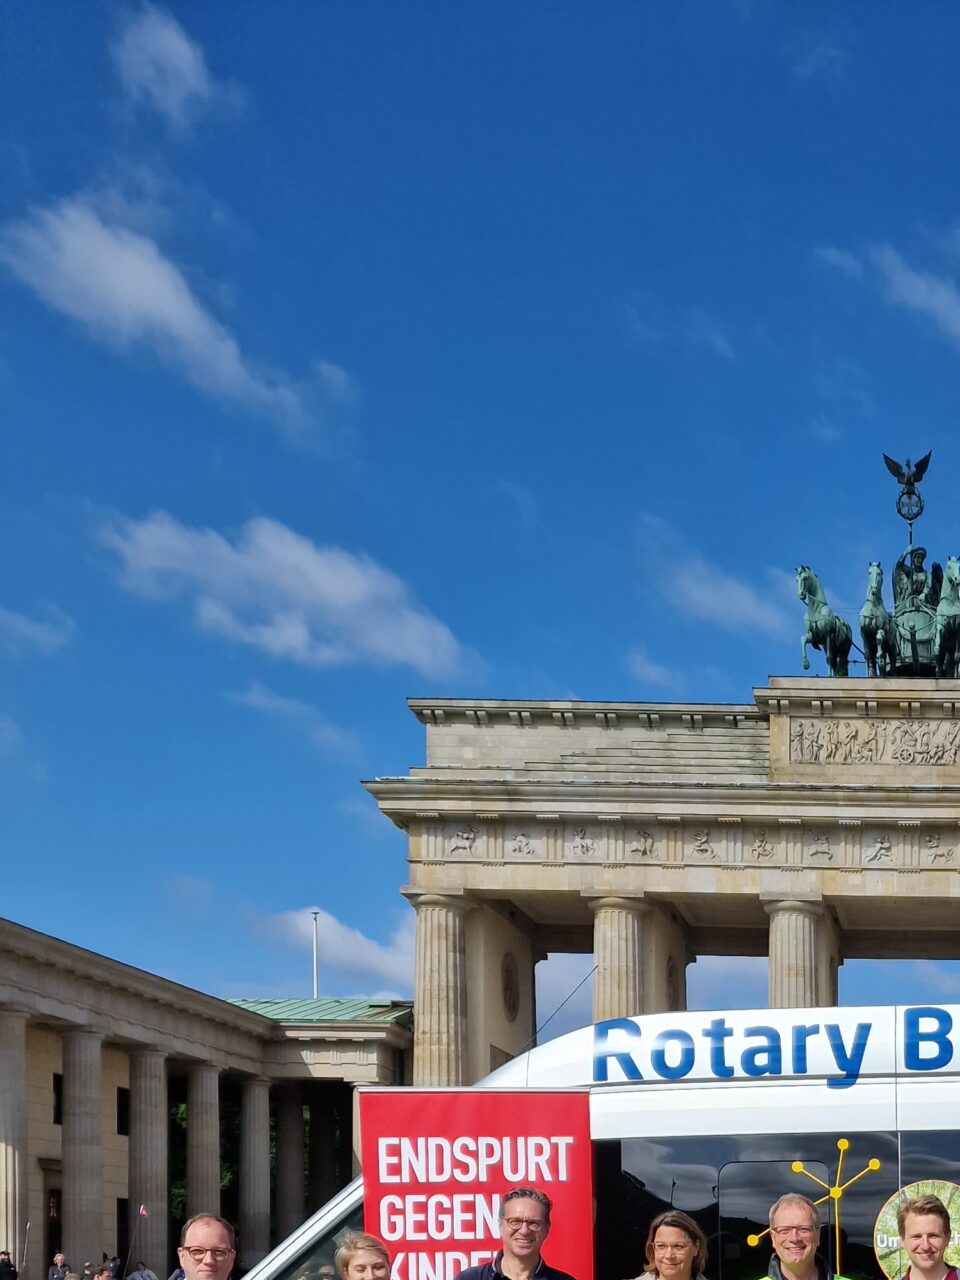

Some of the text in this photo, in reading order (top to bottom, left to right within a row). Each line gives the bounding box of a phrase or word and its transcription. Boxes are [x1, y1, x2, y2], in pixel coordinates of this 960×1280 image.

[593, 1018, 872, 1089] Rotary
[378, 1136, 573, 1183] ENDSPURT
[379, 1193, 501, 1241] GEGEN
